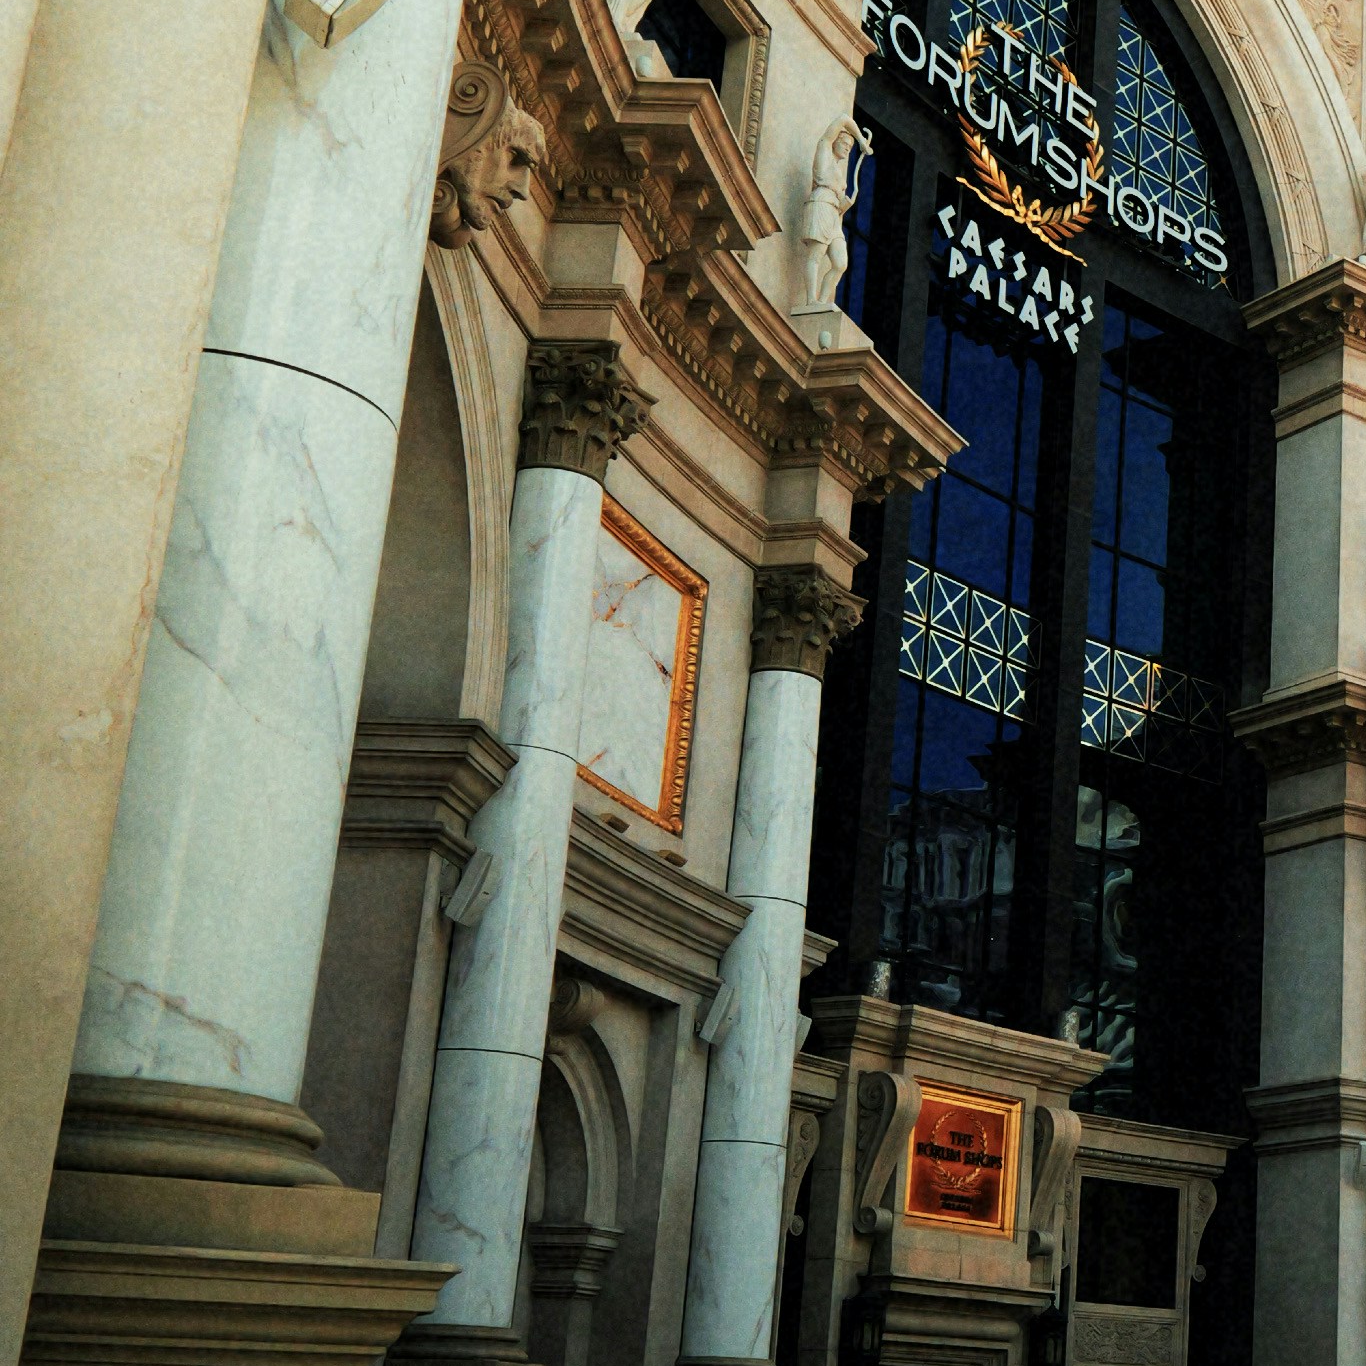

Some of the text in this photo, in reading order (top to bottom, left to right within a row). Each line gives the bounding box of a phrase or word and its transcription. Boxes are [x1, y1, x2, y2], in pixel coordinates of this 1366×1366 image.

[990, 22, 1098, 139] THE
[1044, 138, 1229, 272] SHOPS
[937, 204, 1095, 325] CAESARS
[948, 246, 1081, 355] PALACE
[949, 1130, 975, 1149] THE
